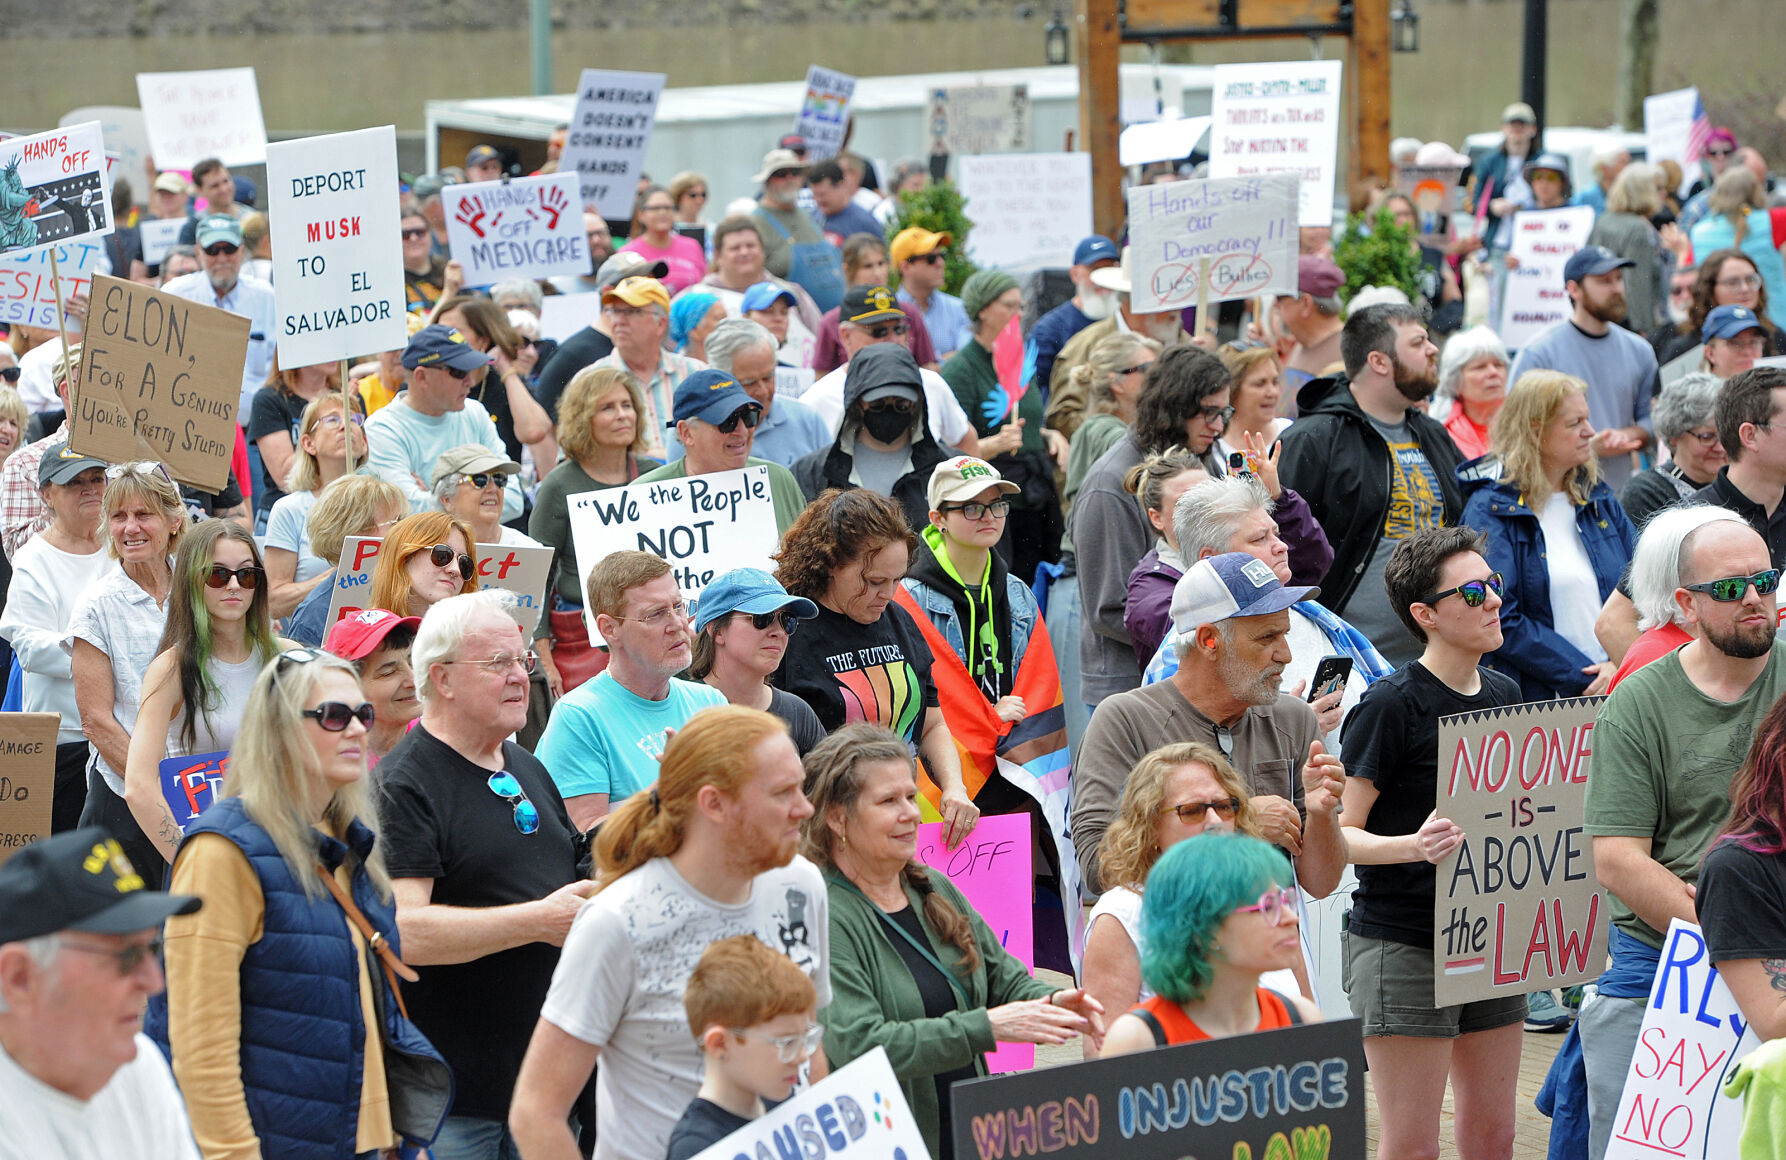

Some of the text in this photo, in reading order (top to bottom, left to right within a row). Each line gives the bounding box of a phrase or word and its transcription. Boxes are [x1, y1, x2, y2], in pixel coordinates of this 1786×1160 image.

[584, 86, 655, 104] AMERICA
[24, 136, 68, 164] HANDS
[569, 131, 645, 149] CONSENT
[62, 149, 91, 174] OFF
[576, 160, 631, 175] HANDS
[291, 168, 367, 198] DEPORT
[581, 184, 609, 200] OFF
[481, 186, 538, 211] HANDS
[1149, 182, 1222, 219] Hands
[1231, 178, 1263, 203] off
[307, 215, 361, 244] MUSK
[499, 220, 533, 239] OFF
[1187, 213, 1220, 233] our
[297, 255, 327, 278] TO
[470, 236, 583, 271] MEDICARE
[350, 271, 372, 293] EL
[1155, 264, 1270, 295] Lies Bullies
[102, 285, 196, 370] ELON,
[284, 300, 392, 337] SALVADOR
[138, 362, 156, 400] A
[959, 465, 993, 480] FISH
[649, 485, 683, 505] the
[637, 520, 714, 560] NOT
[338, 573, 368, 589] the
[826, 652, 857, 672] THE
[0, 740, 43, 756] AMAGE
[1448, 722, 1595, 799] NO ONE
[946, 840, 1015, 878] OFF
[1449, 827, 1587, 899] ABOVE
[1441, 893, 1600, 986] the LAW
[1635, 1027, 1727, 1096] SAY
[970, 1057, 1350, 1160] WHEN INJUSTICE
[1623, 1093, 1694, 1150] NO
